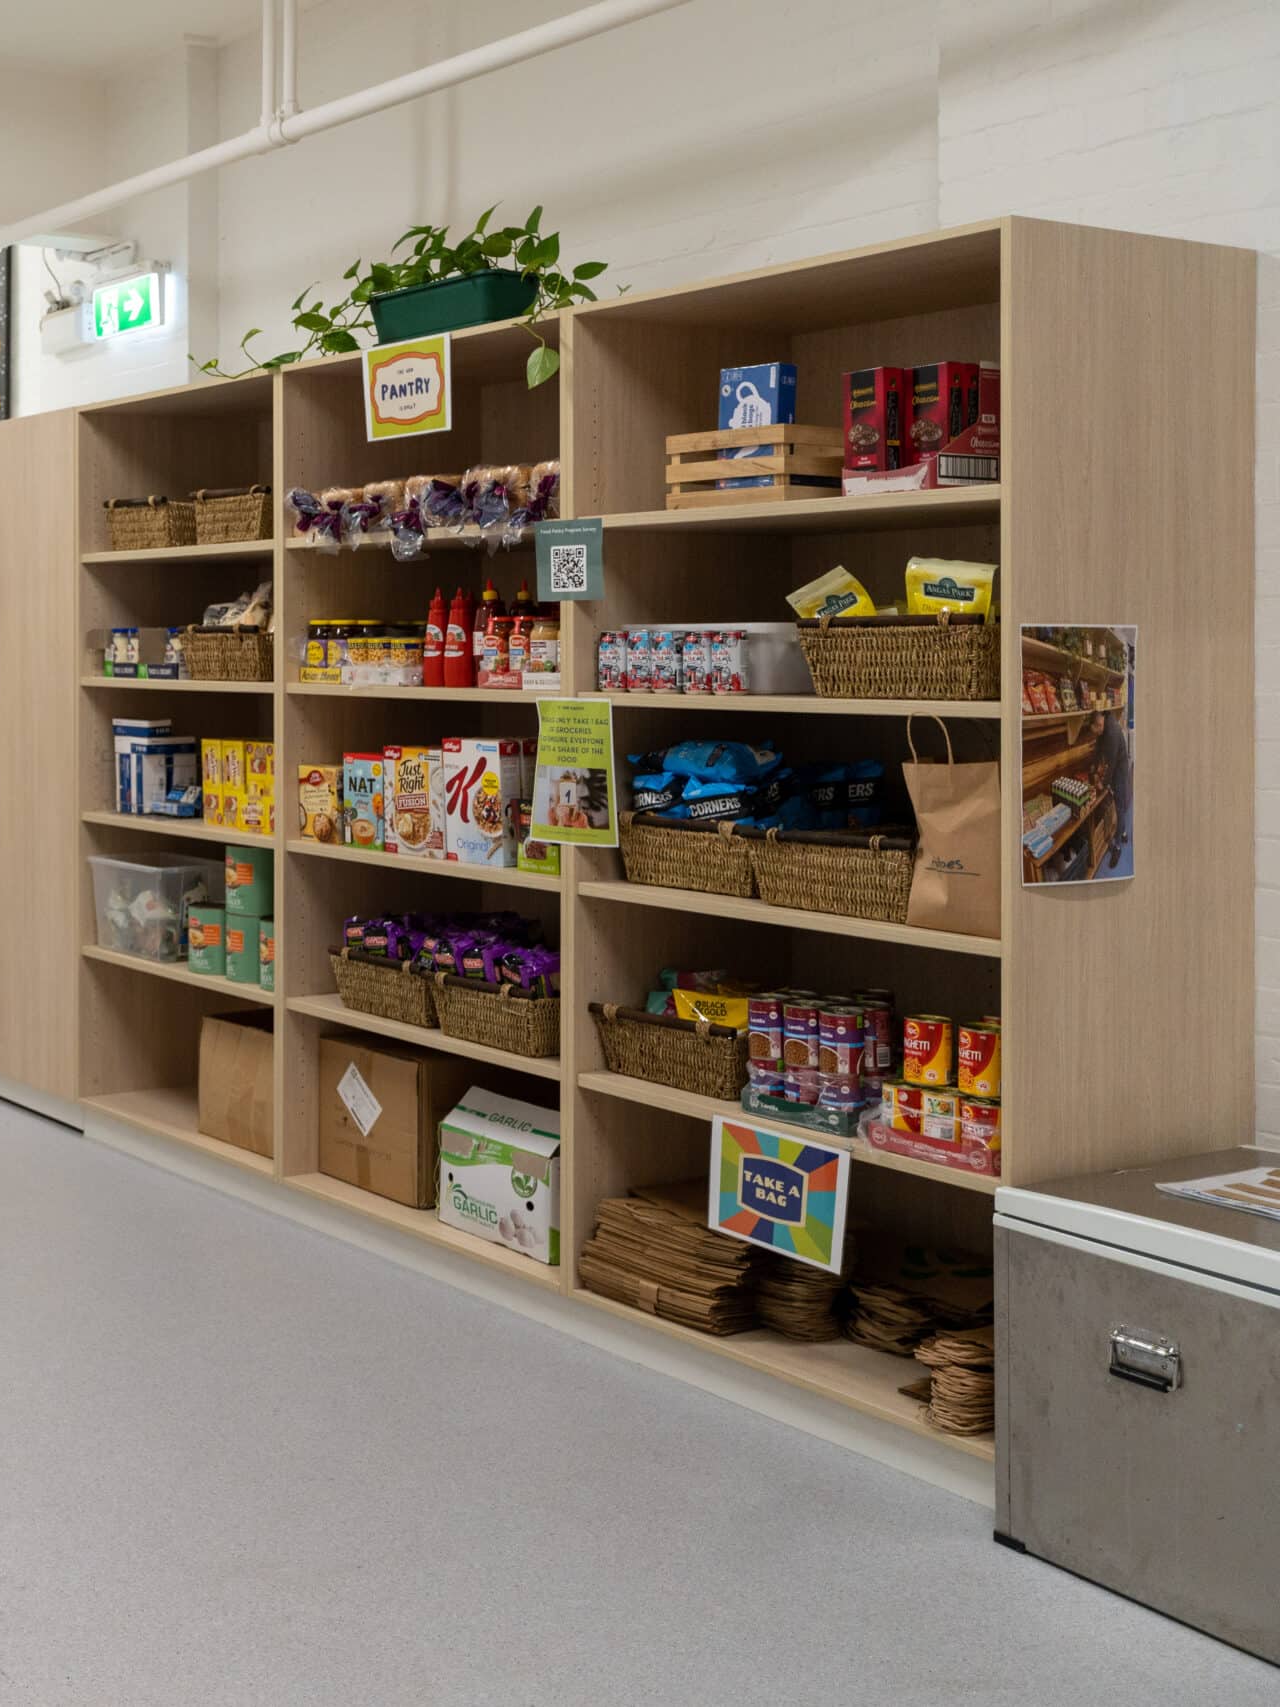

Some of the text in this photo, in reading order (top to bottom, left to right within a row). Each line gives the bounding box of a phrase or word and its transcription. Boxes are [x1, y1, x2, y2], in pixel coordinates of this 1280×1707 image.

[381, 377, 430, 401] PANTRY
[398, 759, 422, 776] Just
[348, 776, 377, 793] NAT
[398, 775, 425, 794] Right
[445, 757, 487, 824] K
[565, 789, 572, 804] 1
[689, 797, 742, 817] CORNERS
[488, 1112, 533, 1133] GARLIC
[744, 1170, 800, 1198] TAKE A
[755, 1187, 787, 1207] BAG
[453, 1196, 499, 1225] GARLIC
